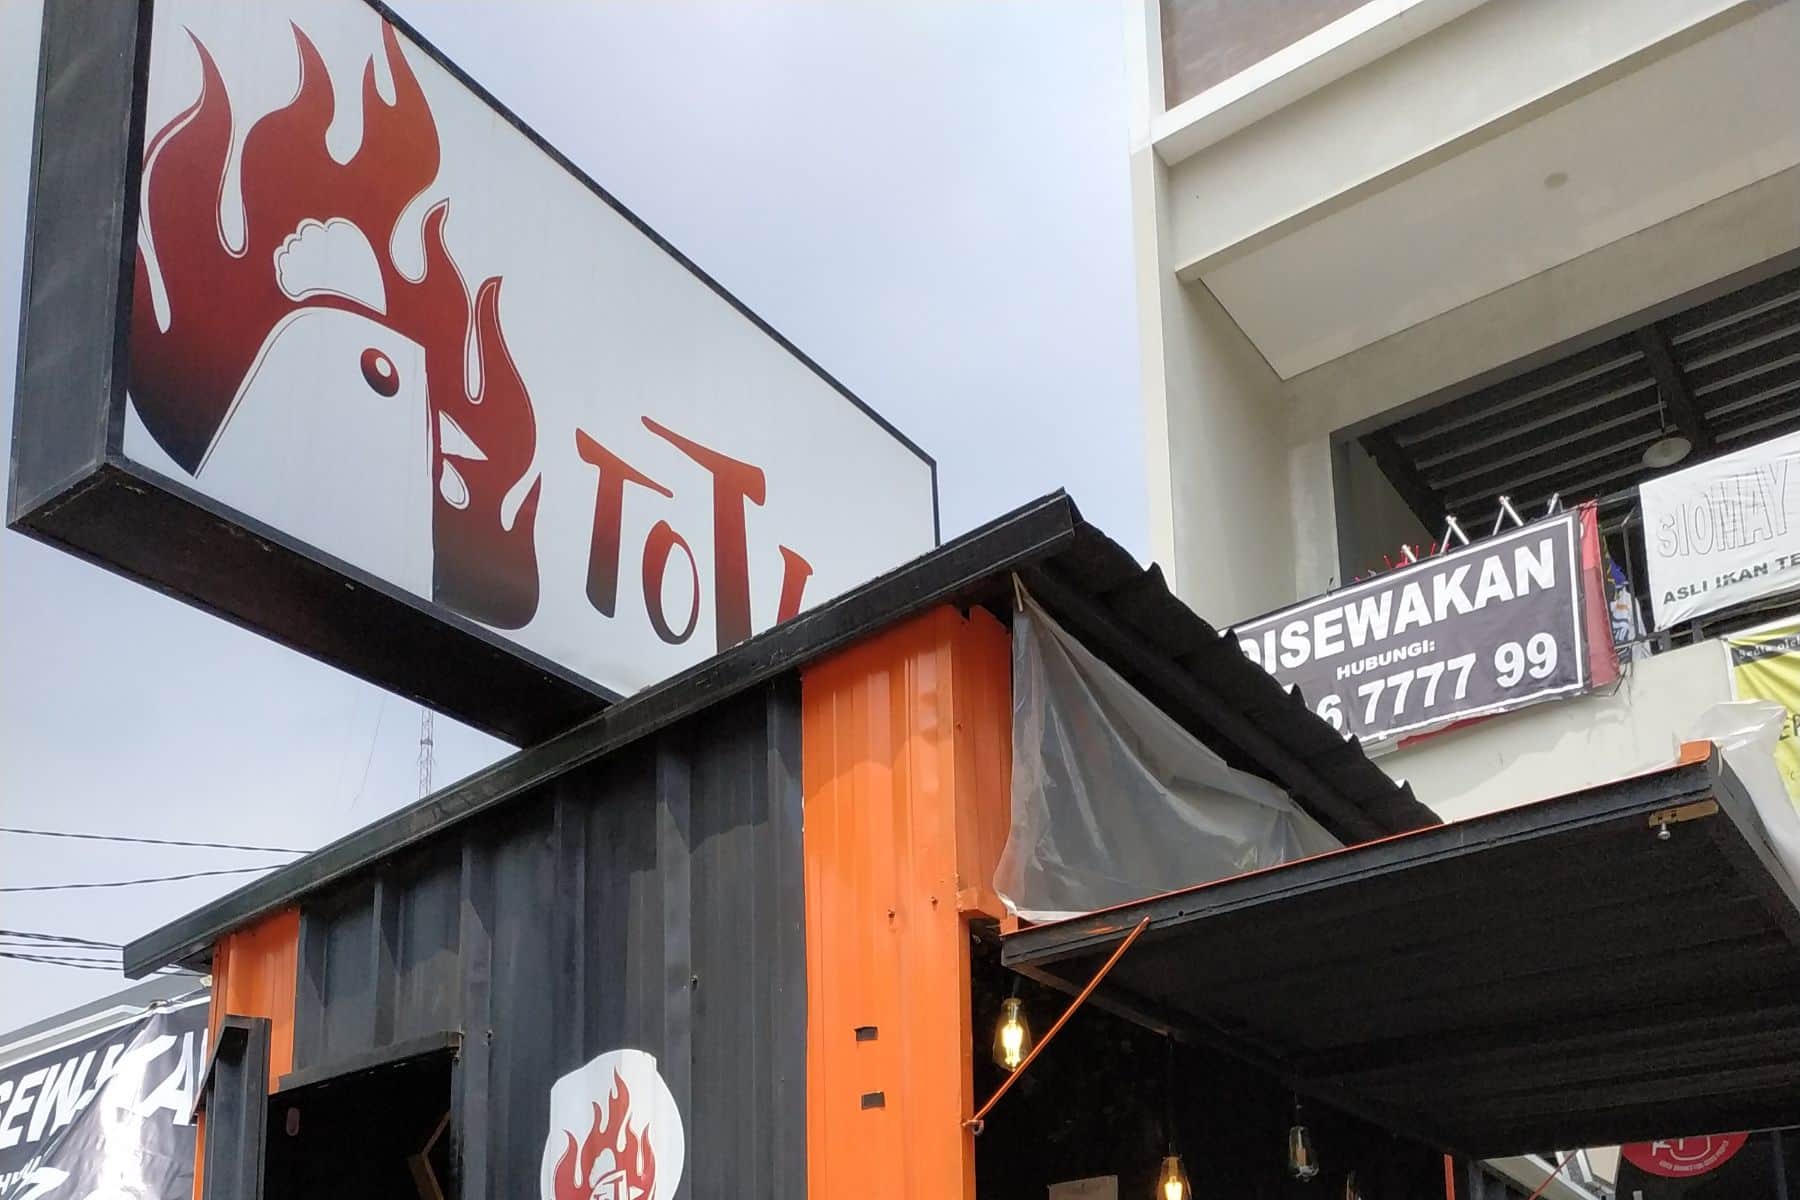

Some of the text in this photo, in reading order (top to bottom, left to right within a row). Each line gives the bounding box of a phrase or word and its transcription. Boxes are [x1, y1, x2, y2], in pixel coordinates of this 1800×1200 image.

[1657, 459, 1789, 558] SIOMAY
[1663, 580, 1708, 604] ASLI
[1715, 562, 1769, 588] IKAN
[1336, 640, 1436, 680] HUBUNGI:
[1358, 653, 1477, 724] 7777
[1494, 632, 1558, 688] 99
